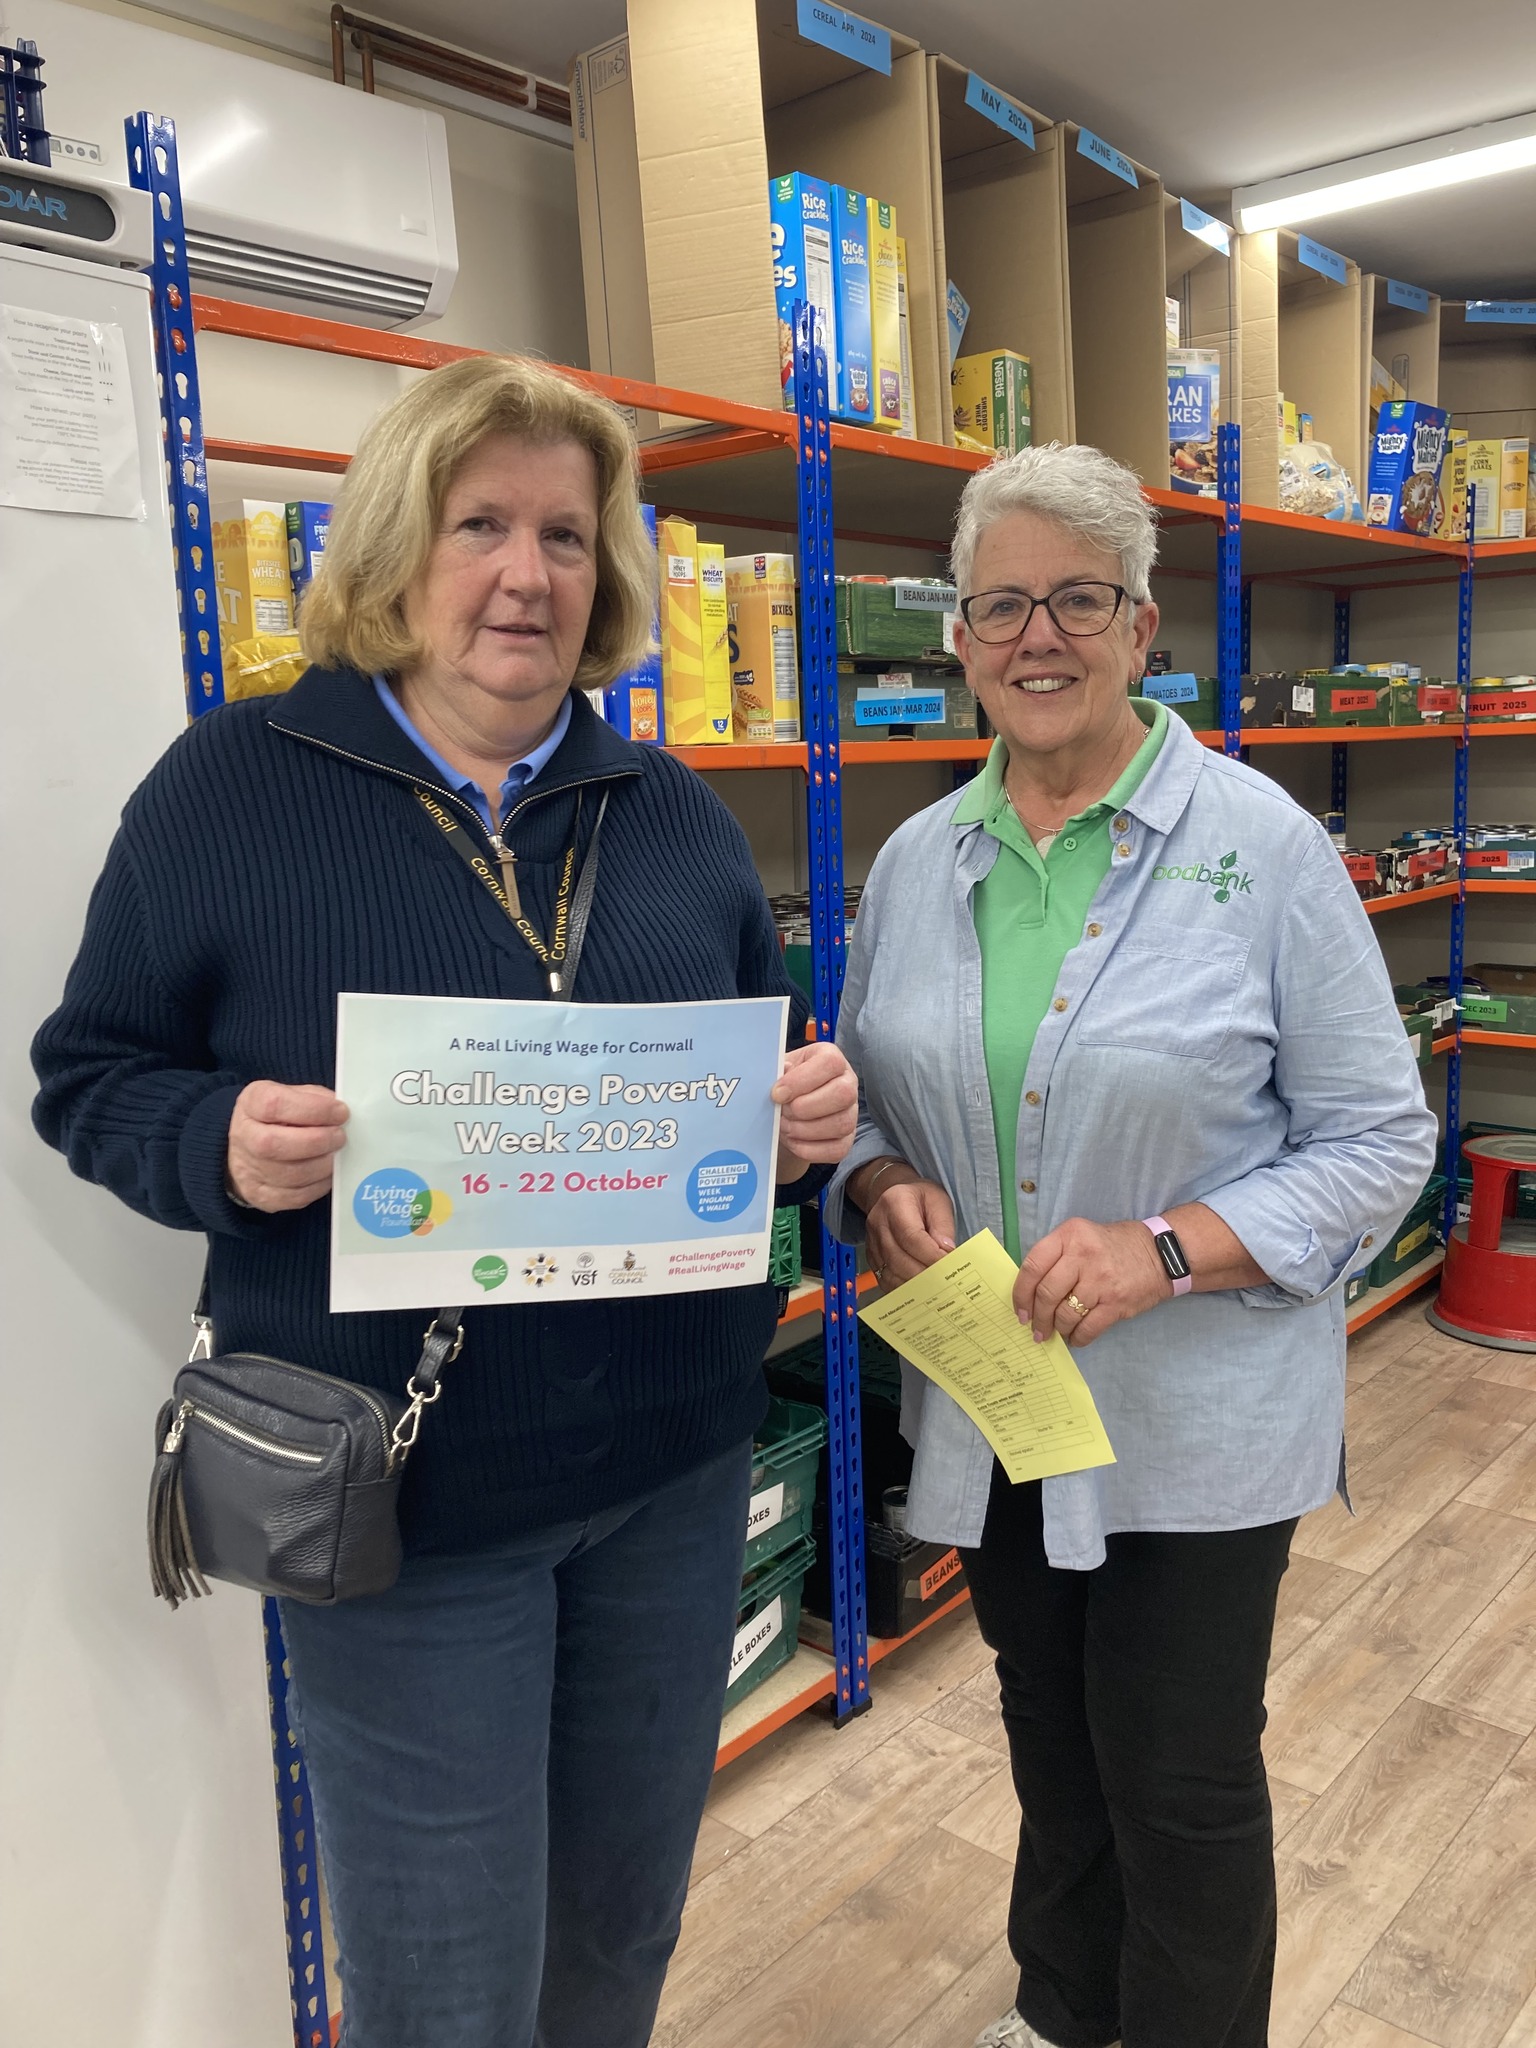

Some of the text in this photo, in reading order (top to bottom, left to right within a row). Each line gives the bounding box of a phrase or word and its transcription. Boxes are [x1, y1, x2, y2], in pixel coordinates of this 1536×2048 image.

[812, 8, 876, 45] CEREAL APR 2024
[981, 88, 1028, 134] MAY 2024
[1089, 138, 1133, 177] JUNE 2024
[801, 192, 826, 211] Rice
[802, 209, 830, 222] Crackles
[841, 239, 865, 256] Rice
[980, 396, 988, 432] SHREDDED
[1380, 436, 1403, 446] Mighty
[1417, 430, 1442, 450] Mighty
[256, 559, 281, 569] BITESIZE
[252, 567, 286, 580] WHEAT
[702, 569, 723, 577] WHEAT
[903, 590, 926, 601] BEANS
[771, 605, 793, 616] BIXIES
[1146, 687, 1194, 700] TOMATOES 2024
[1339, 697, 1354, 706] MEAT
[1502, 701, 1527, 710] 2025
[636, 706, 653, 714] LOOPS
[863, 703, 941, 718] BEANS JAN-MAR 2024
[717, 720, 724, 728] 12
[1481, 855, 1501, 863] 2025
[550, 896, 568, 961] Cornwall
[1462, 1005, 1497, 1014] DEC 2023
[449, 1038, 693, 1056] A Real Living Wage for Cornwall
[390, 1070, 741, 1115] Challenge Poverty
[454, 1118, 679, 1154] Week 2023
[700, 1165, 747, 1176] CHALLENGE
[461, 1173, 490, 1194] 16
[518, 1172, 555, 1192] 22
[563, 1168, 669, 1193] October
[699, 1176, 736, 1186] POVERTY
[361, 1184, 418, 1203] Living
[698, 1187, 721, 1196] WEEK
[698, 1194, 735, 1205] ENGLAND
[373, 1200, 423, 1218] Wage
[706, 1203, 730, 1212] WALES
[669, 1247, 756, 1263] #ChallengePoverty
[668, 1261, 746, 1276] #RealLivingWage
[571, 1270, 598, 1286] vsf
[925, 1554, 960, 1591] BEANS
[744, 1622, 772, 1655] BOXES
